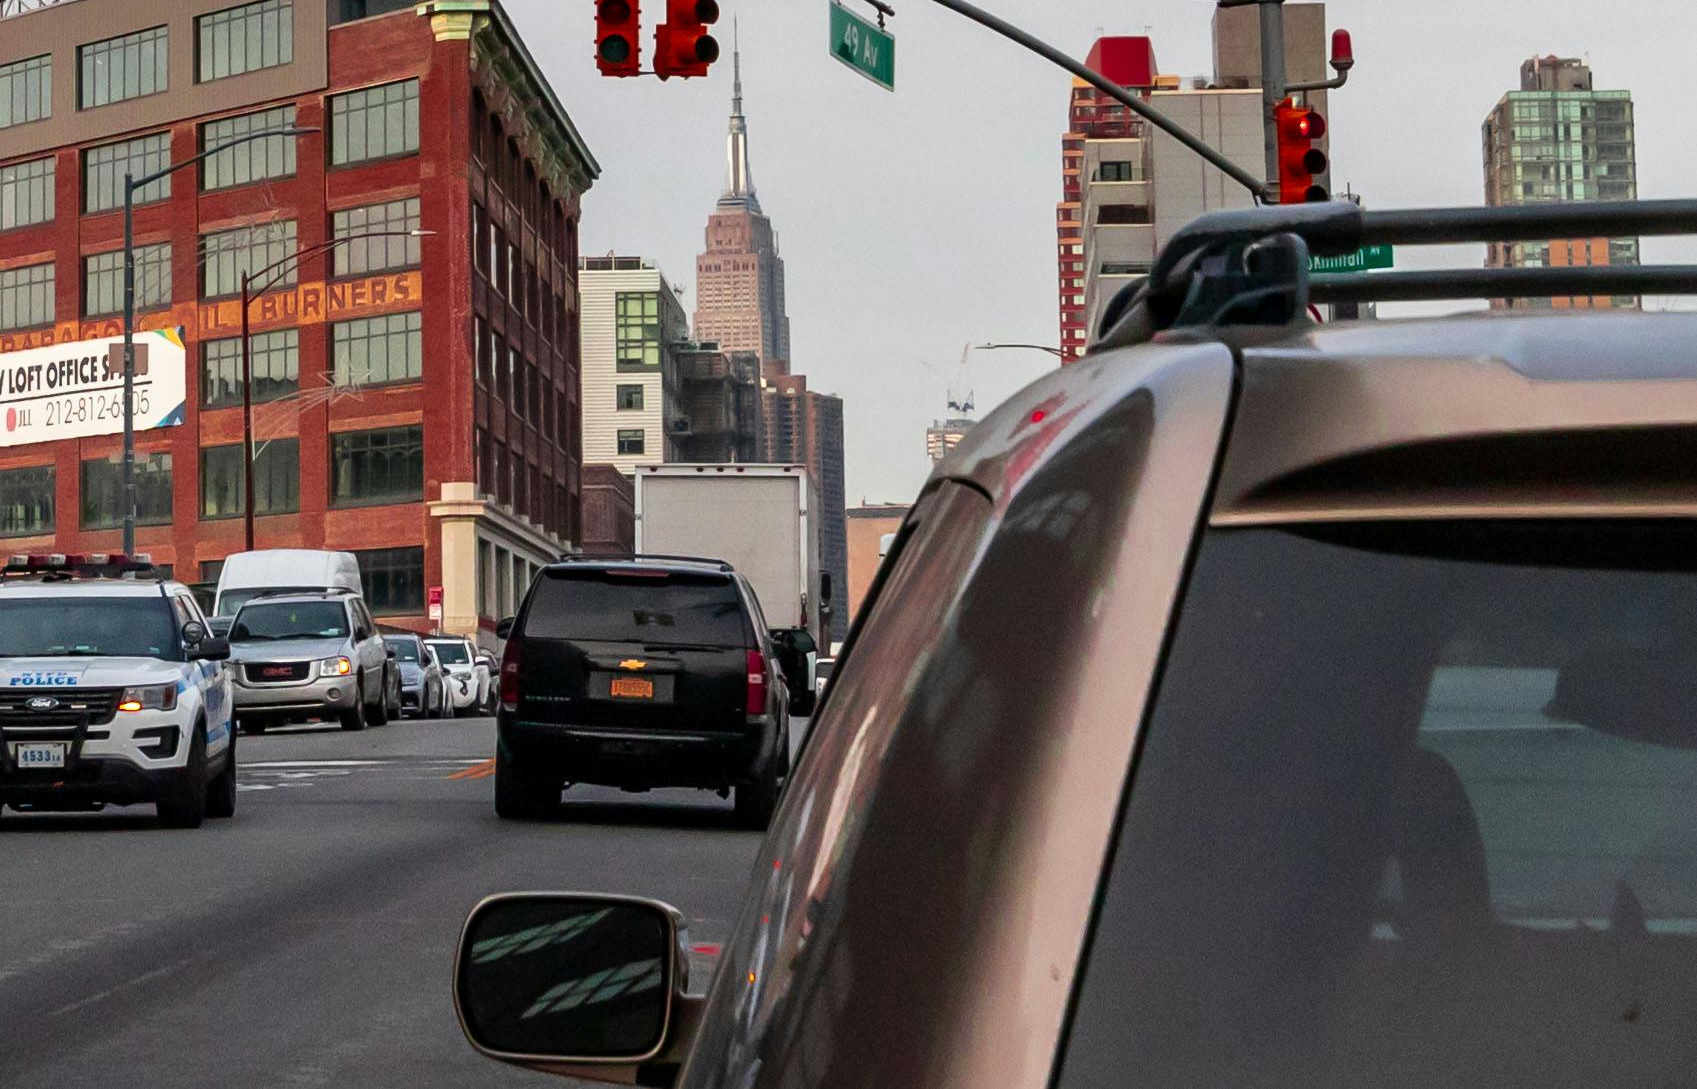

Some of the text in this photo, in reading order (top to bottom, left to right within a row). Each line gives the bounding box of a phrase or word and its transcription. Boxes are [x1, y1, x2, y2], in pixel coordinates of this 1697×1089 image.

[844, 21, 859, 57] 49
[260, 274, 410, 320] BURNERS
[8, 364, 42, 394] LOFT
[46, 356, 98, 389] OFFICE
[9, 677, 78, 687] POLICE
